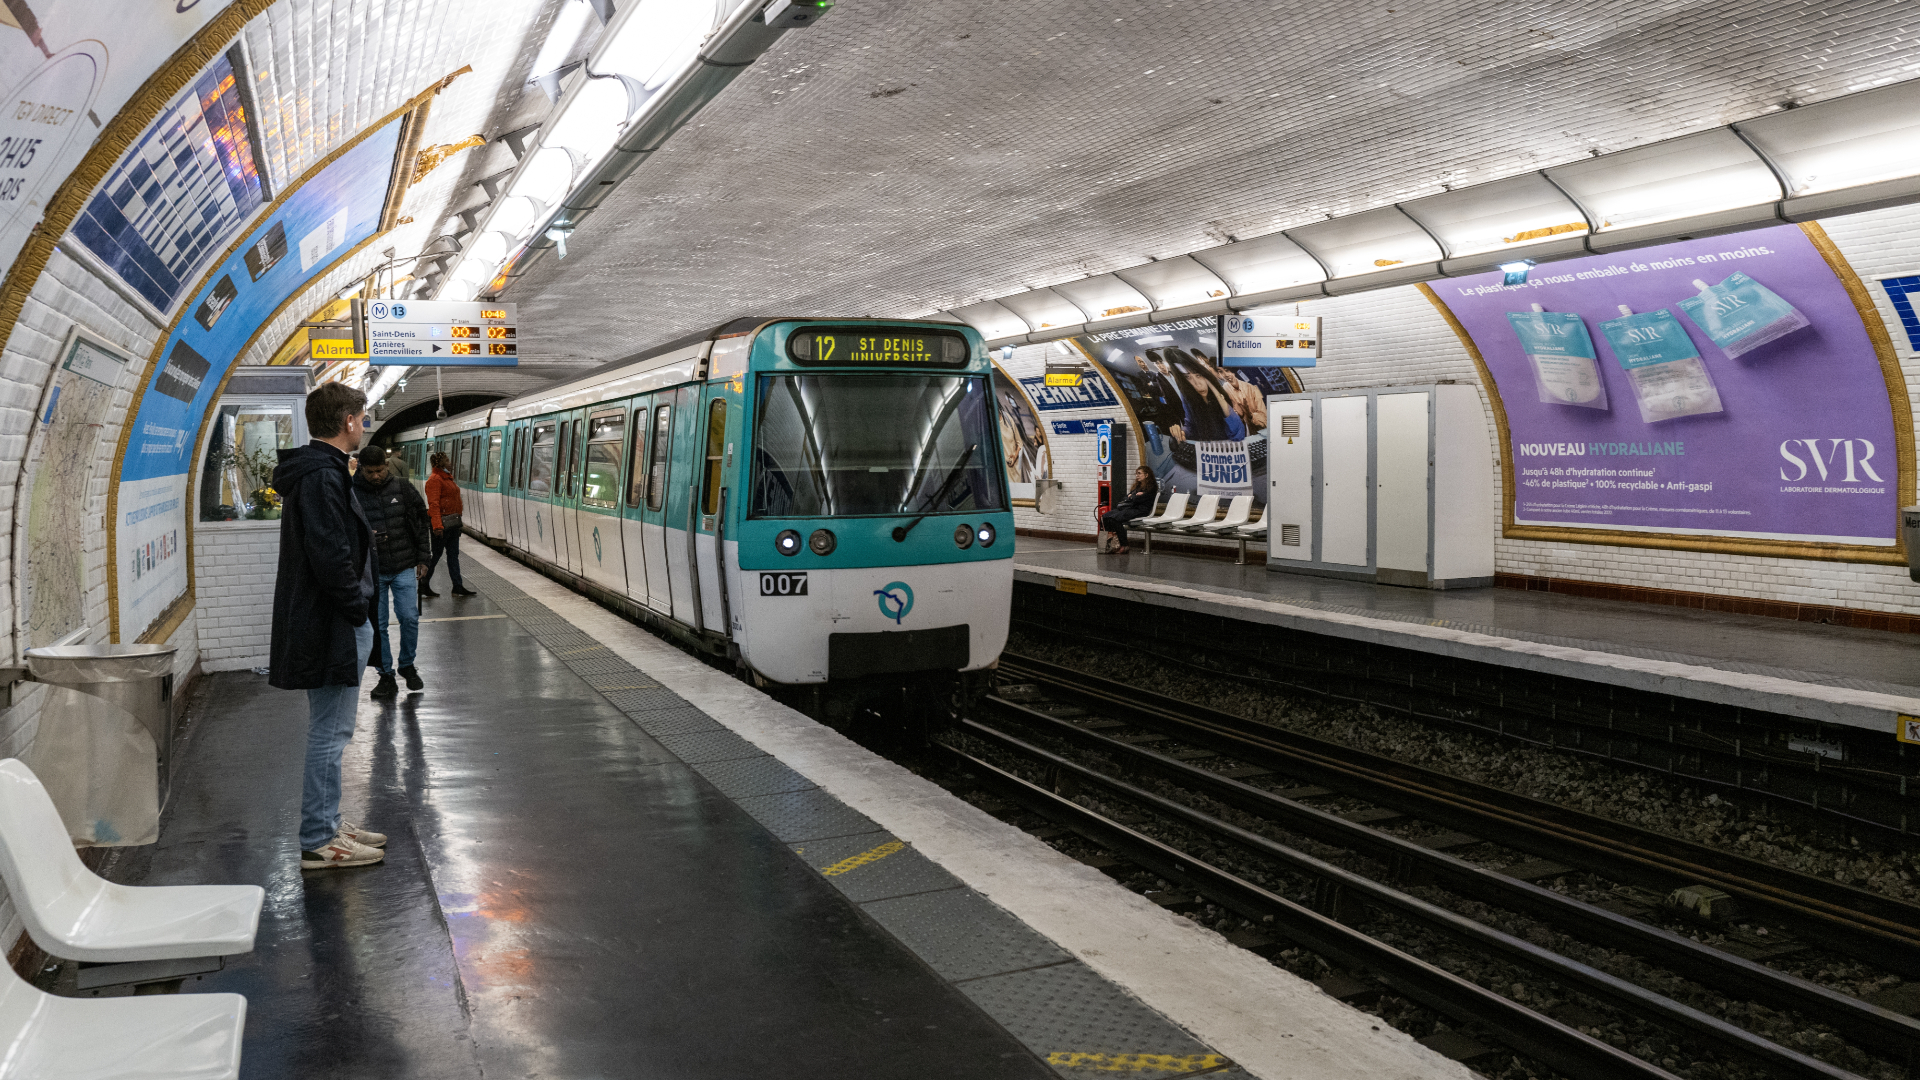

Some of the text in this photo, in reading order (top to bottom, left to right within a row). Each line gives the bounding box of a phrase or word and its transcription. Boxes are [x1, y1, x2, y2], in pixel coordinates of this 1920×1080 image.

[1458, 287, 1475, 296] Le
[1529, 278, 1544, 289] ça
[1544, 273, 1575, 285] nous
[1576, 265, 1629, 281] emballe
[1630, 262, 1649, 273] de
[1650, 256, 1695, 271] moins
[1697, 254, 1718, 264] en
[1718, 246, 1775, 261] moins.
[392, 306, 405, 316] 13
[1711, 294, 1747, 316] SVR
[481, 310, 506, 318] 10:48
[1087, 316, 1216, 343] LA PIRE SEMAINE DE LEUR VIE
[1243, 321, 1253, 330] 13
[1534, 323, 1565, 335] SVR
[451, 326, 470, 338] 00
[487, 327, 506, 339] 02
[1628, 326, 1661, 343] SVR
[315, 344, 355, 355] Alarm
[451, 343, 470, 355] 05
[489, 343, 506, 355] 10
[860, 338, 924, 352] ST DENIS
[1226, 340, 1261, 349] Châtillon
[373, 347, 422, 355] Gennevilliers
[1024, 376, 1110, 405] PERNETY
[1520, 442, 1685, 457] NOUVEAU HYDRALIANE
[1201, 453, 1246, 464] comme un
[1780, 438, 1885, 482] SVR
[1202, 463, 1248, 484] LUNDI
[1522, 467, 1548, 477] Jusqu'à
[1549, 467, 1564, 476] 48h
[1565, 467, 1617, 478] d'hydratation
[1522, 479, 1540, 488] -46%
[1541, 479, 1551, 488] de
[1595, 480, 1617, 489] 100%
[1617, 481, 1659, 491] recyclable
[1666, 481, 1713, 493] Anti-gaspi
[762, 574, 807, 594] 007
